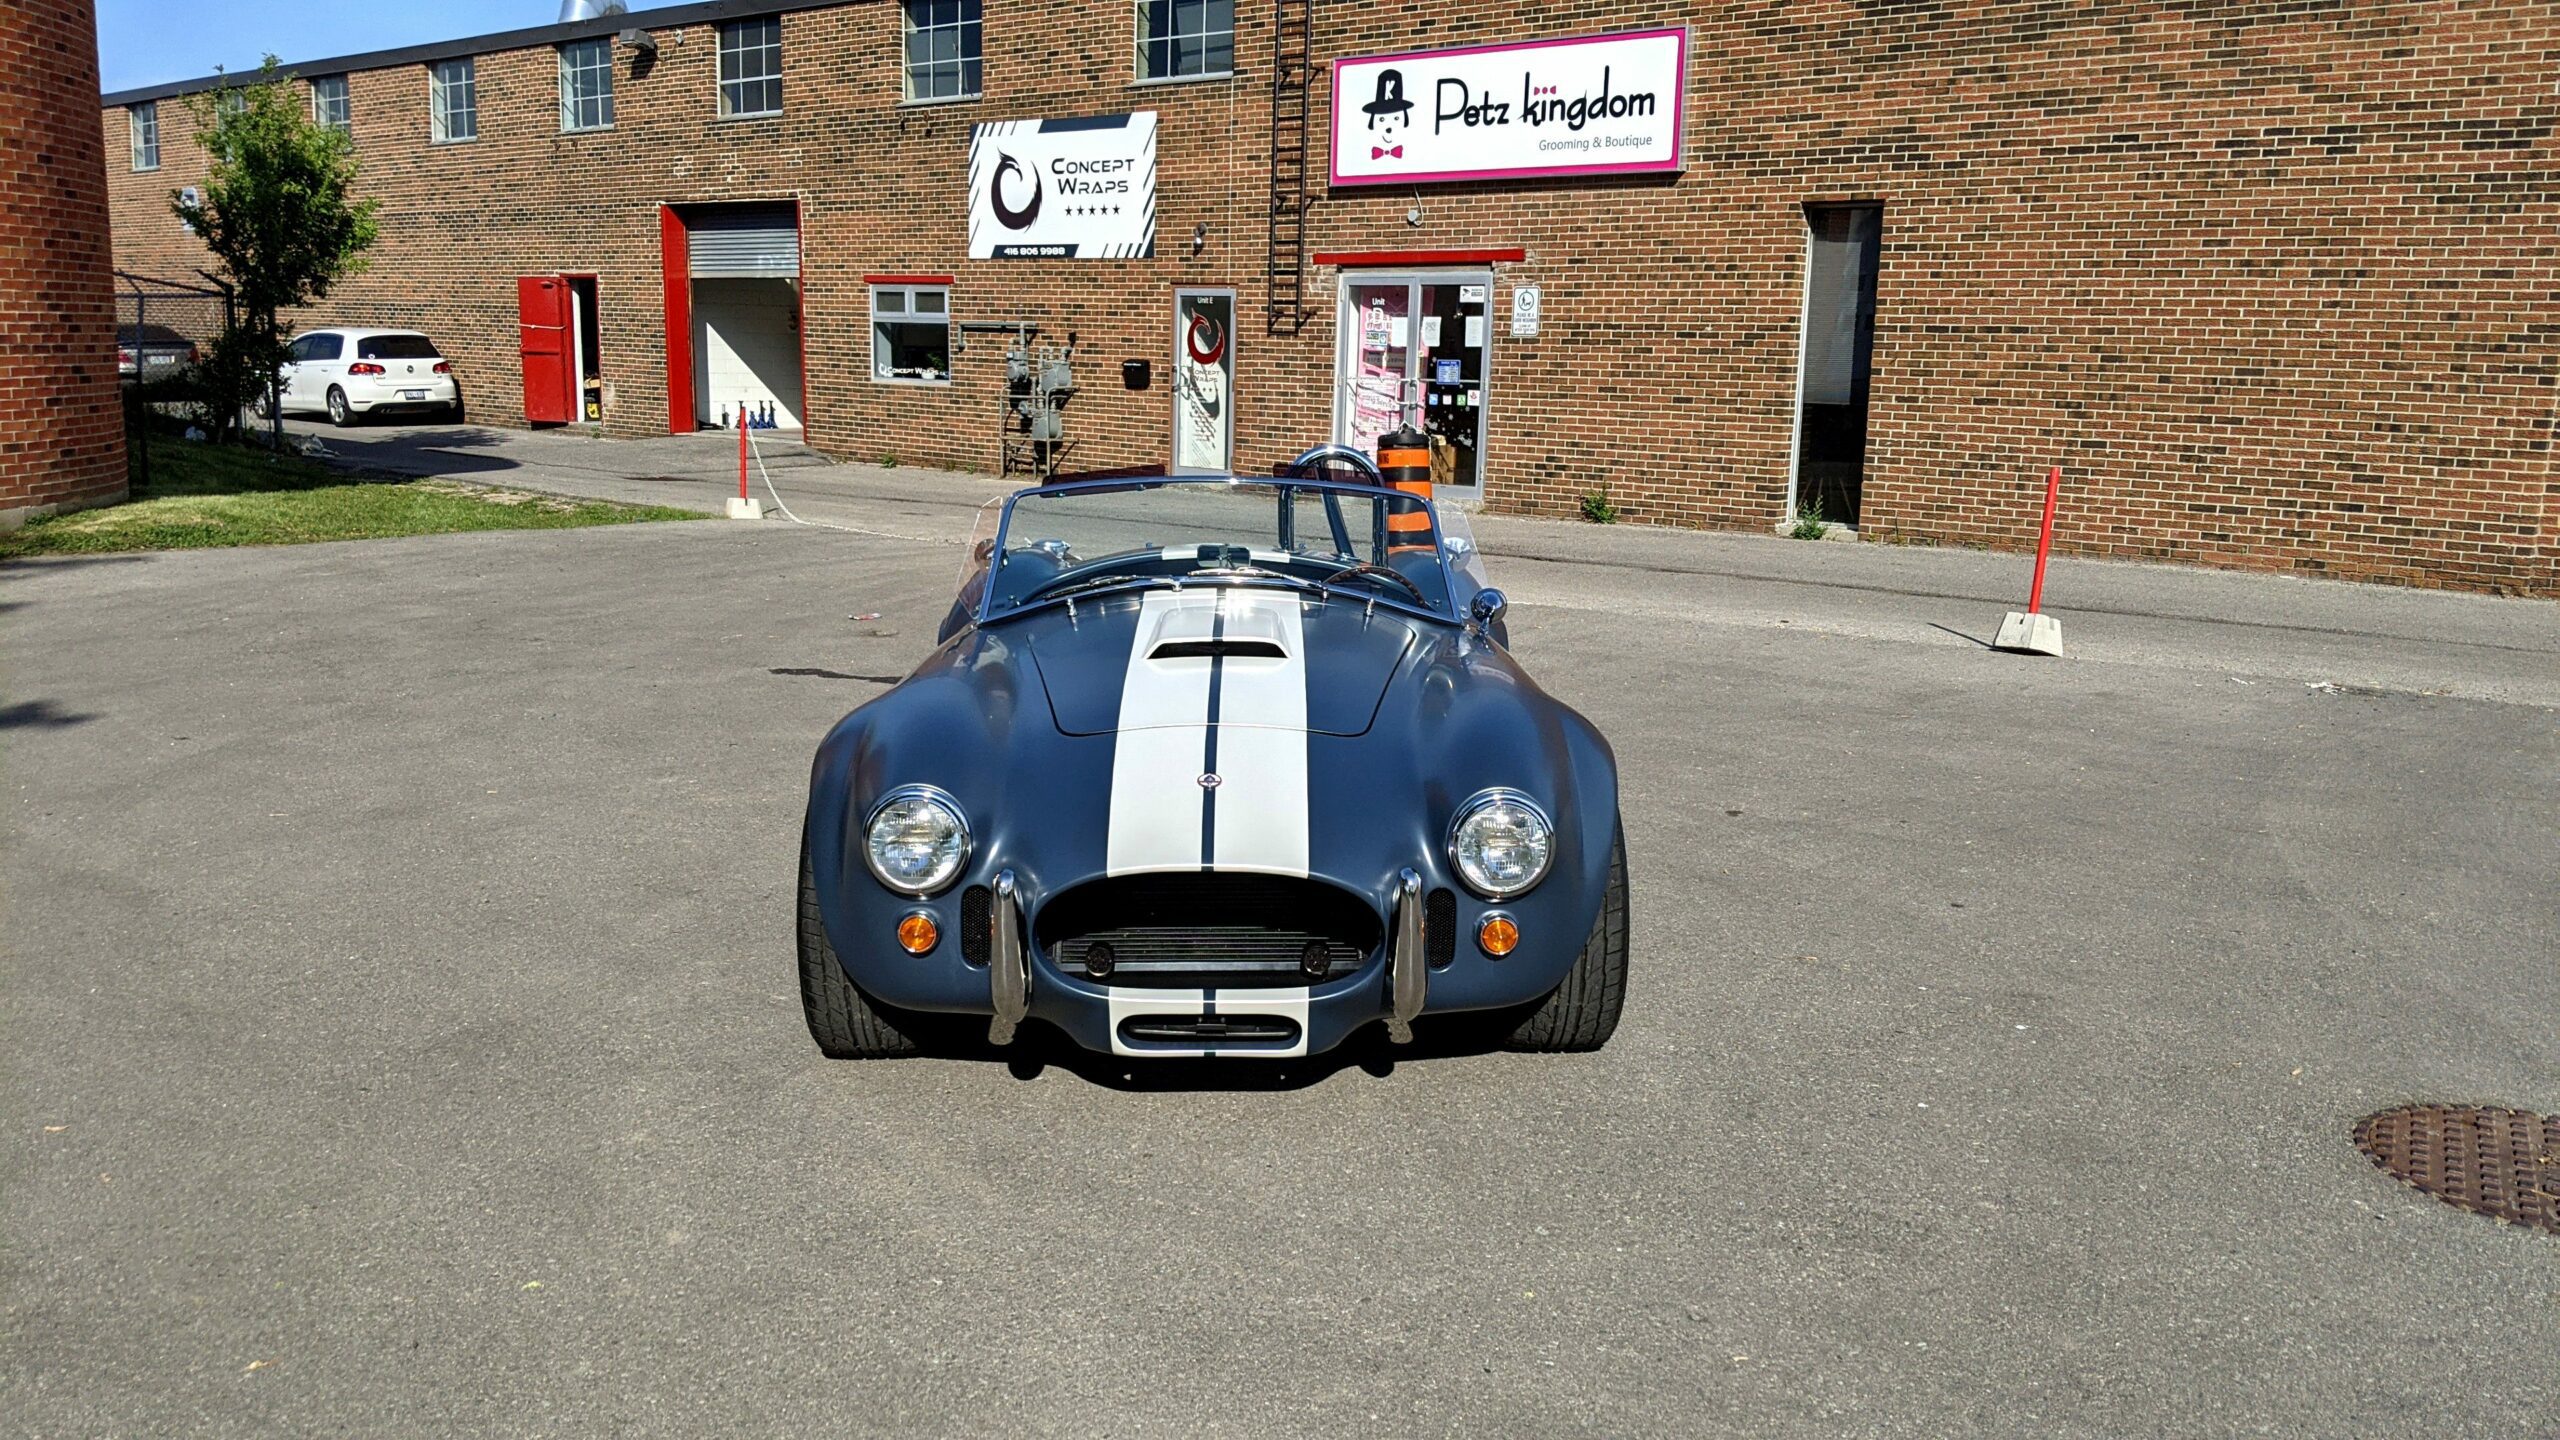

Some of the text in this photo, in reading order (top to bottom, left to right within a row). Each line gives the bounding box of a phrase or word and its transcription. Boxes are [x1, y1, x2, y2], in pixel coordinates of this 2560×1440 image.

[1385, 80, 1395, 100] K
[1435, 65, 1655, 135] Petz kingdom
[1538, 134, 1653, 151] Grooming & Boutique
[1051, 157, 1135, 175] CONCEPT
[1057, 177, 1129, 195] WRAPS
[1003, 246, 1066, 256] 416 806 9988
[1371, 297, 1386, 306] Unit
